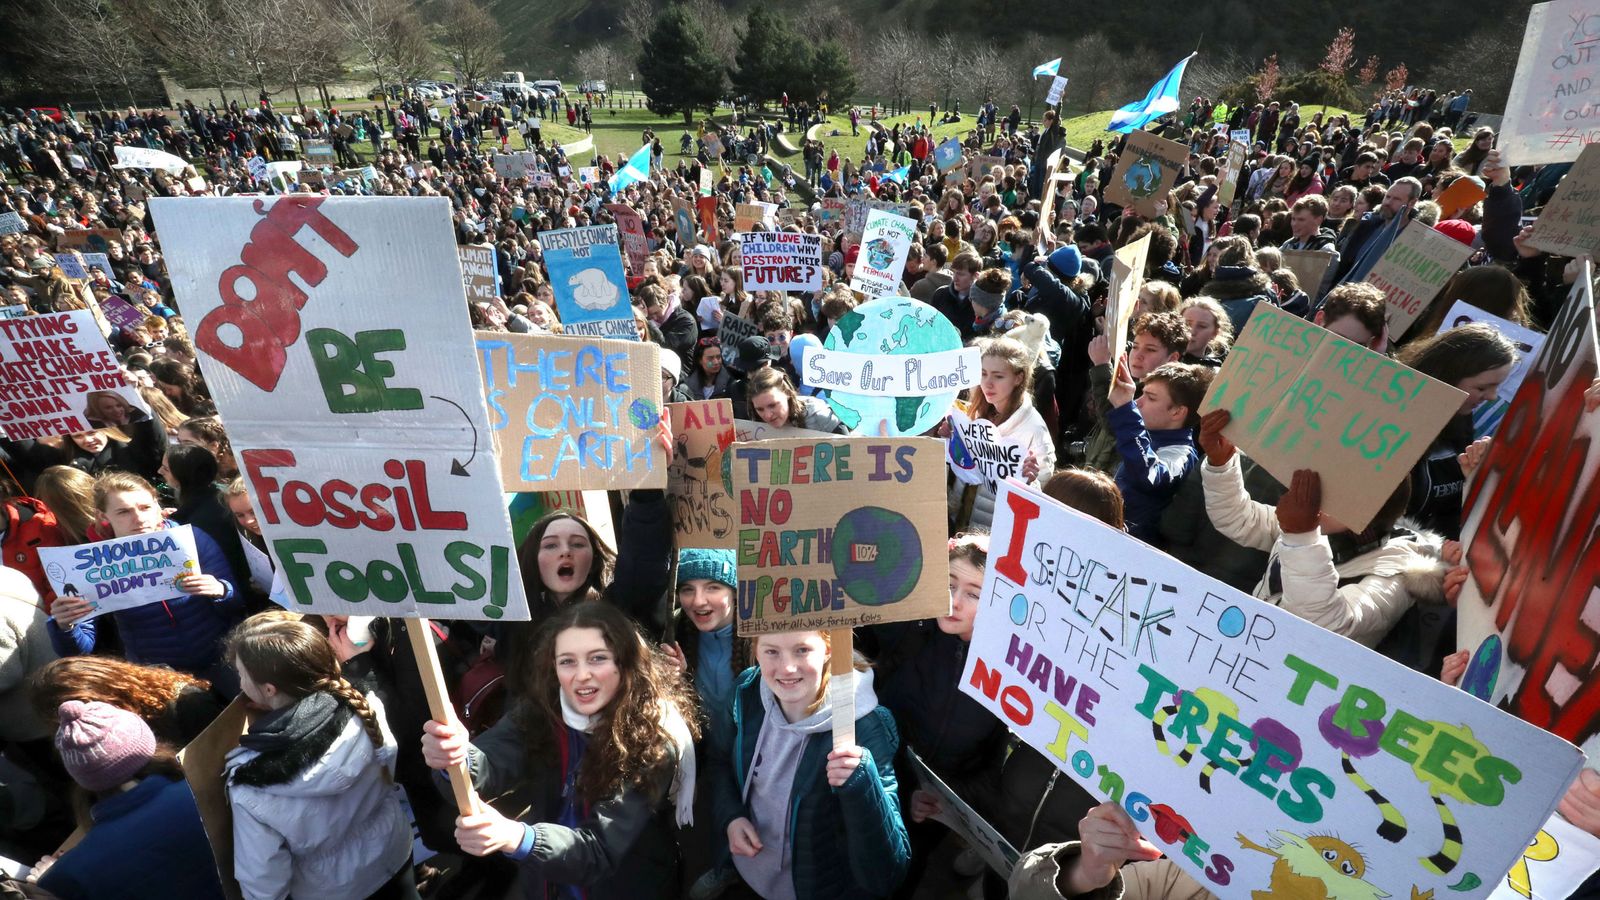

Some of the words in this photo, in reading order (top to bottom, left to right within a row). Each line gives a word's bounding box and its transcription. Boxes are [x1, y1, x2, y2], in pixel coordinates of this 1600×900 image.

[1552, 44, 1597, 70] OUT
[1554, 77, 1592, 98] AND
[866, 217, 889, 231] CLIMATE
[878, 228, 885, 236] IS
[887, 230, 901, 239] NOT
[541, 230, 588, 251] LIFESTYLE
[587, 227, 616, 245] CHANGE
[573, 247, 590, 257] NOT
[742, 233, 757, 243] IF
[760, 233, 776, 242] YOU
[777, 233, 800, 243] LOVE
[802, 235, 820, 246] YOUR
[797, 245, 817, 255] WHY
[743, 255, 791, 265] DESTROY
[791, 256, 820, 266] THEIR
[863, 266, 895, 282] TERMINAL
[195, 194, 360, 392] DON'T
[860, 283, 884, 297] FUTURE
[0, 314, 78, 341] TRYING
[605, 320, 638, 335] CHANGE
[1534, 286, 1592, 390] NO
[12, 337, 83, 362] MAKE
[1251, 311, 1322, 358] TREES
[1325, 339, 1428, 412] TREES!
[39, 350, 117, 378] CHANGE
[305, 327, 425, 413] BE
[475, 340, 631, 393] THERE
[809, 353, 852, 384] Save
[861, 360, 894, 391] Our
[904, 355, 970, 391] Planet
[49, 375, 89, 397] IT'S
[90, 372, 127, 391] NOT
[487, 390, 510, 431] S
[526, 391, 624, 436] ONLY
[684, 402, 730, 430] ALL
[1228, 346, 1293, 397] THEY
[1338, 410, 1413, 473] US!
[2, 415, 85, 442] HAPPEN
[960, 423, 994, 443] WE'RE
[520, 430, 654, 482] EARTH
[736, 442, 854, 485] THERE
[866, 444, 917, 483] IS
[964, 437, 1021, 464] RUNNING
[996, 463, 1019, 480] OF
[740, 487, 793, 526] NO
[738, 528, 833, 568] EARTH
[857, 545, 877, 561] 10%
[994, 491, 1041, 587] I
[273, 538, 510, 619] FOOLS!
[738, 575, 846, 620] UPGRADE
[1030, 541, 1176, 664] SPEAK
[770, 619, 788, 631] not
[1197, 591, 1276, 652] FOR
[1186, 625, 1270, 703] THE
[969, 657, 1034, 727] NO
[1004, 633, 1101, 728] HAVE
[990, 576, 1047, 642] FOR
[1061, 617, 1127, 691] THE
[1134, 663, 1336, 824] TREES
[1283, 653, 1522, 807] TREES
